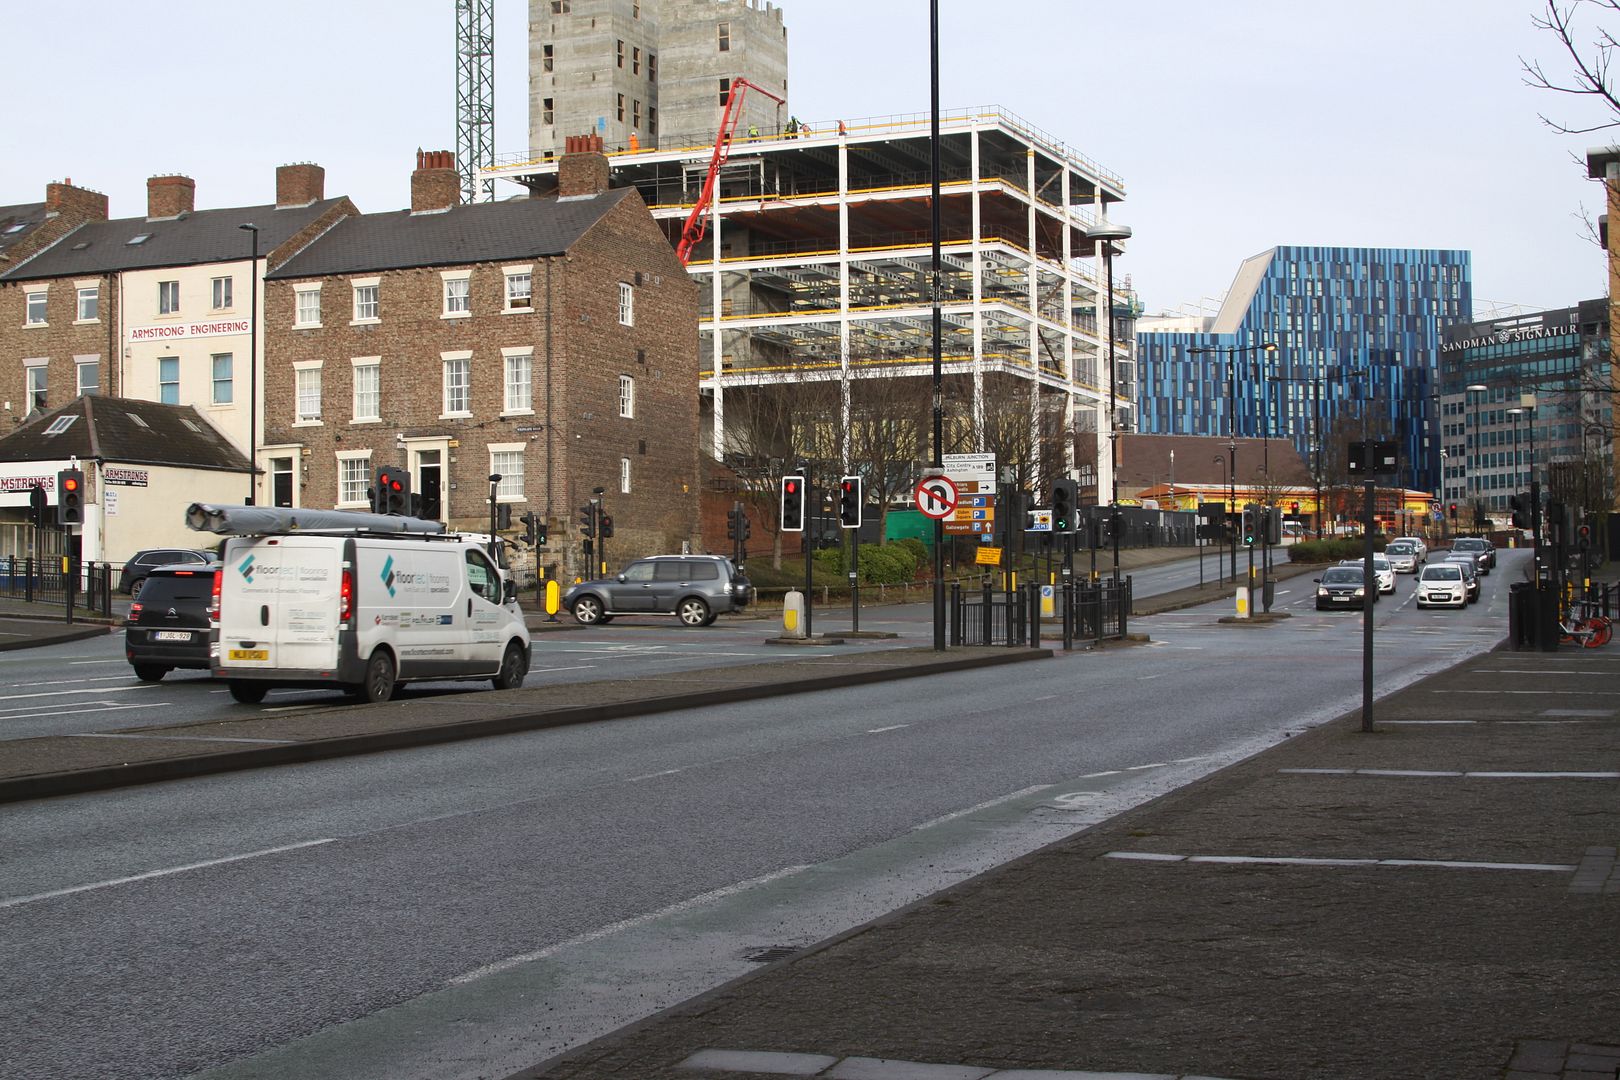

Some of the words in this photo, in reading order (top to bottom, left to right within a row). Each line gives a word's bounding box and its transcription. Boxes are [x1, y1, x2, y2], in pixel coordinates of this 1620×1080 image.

[132, 326, 184, 339] ARMSTRONG
[191, 321, 248, 335] ENGINEERING
[1442, 336, 1495, 353] SANDMAN
[1515, 324, 1577, 342] SIGNATUR
[105, 469, 148, 481] ARMSTRONGS
[0, 477, 54, 490] MSTRONGS
[974, 498, 980, 506] P
[974, 522, 980, 530] P
